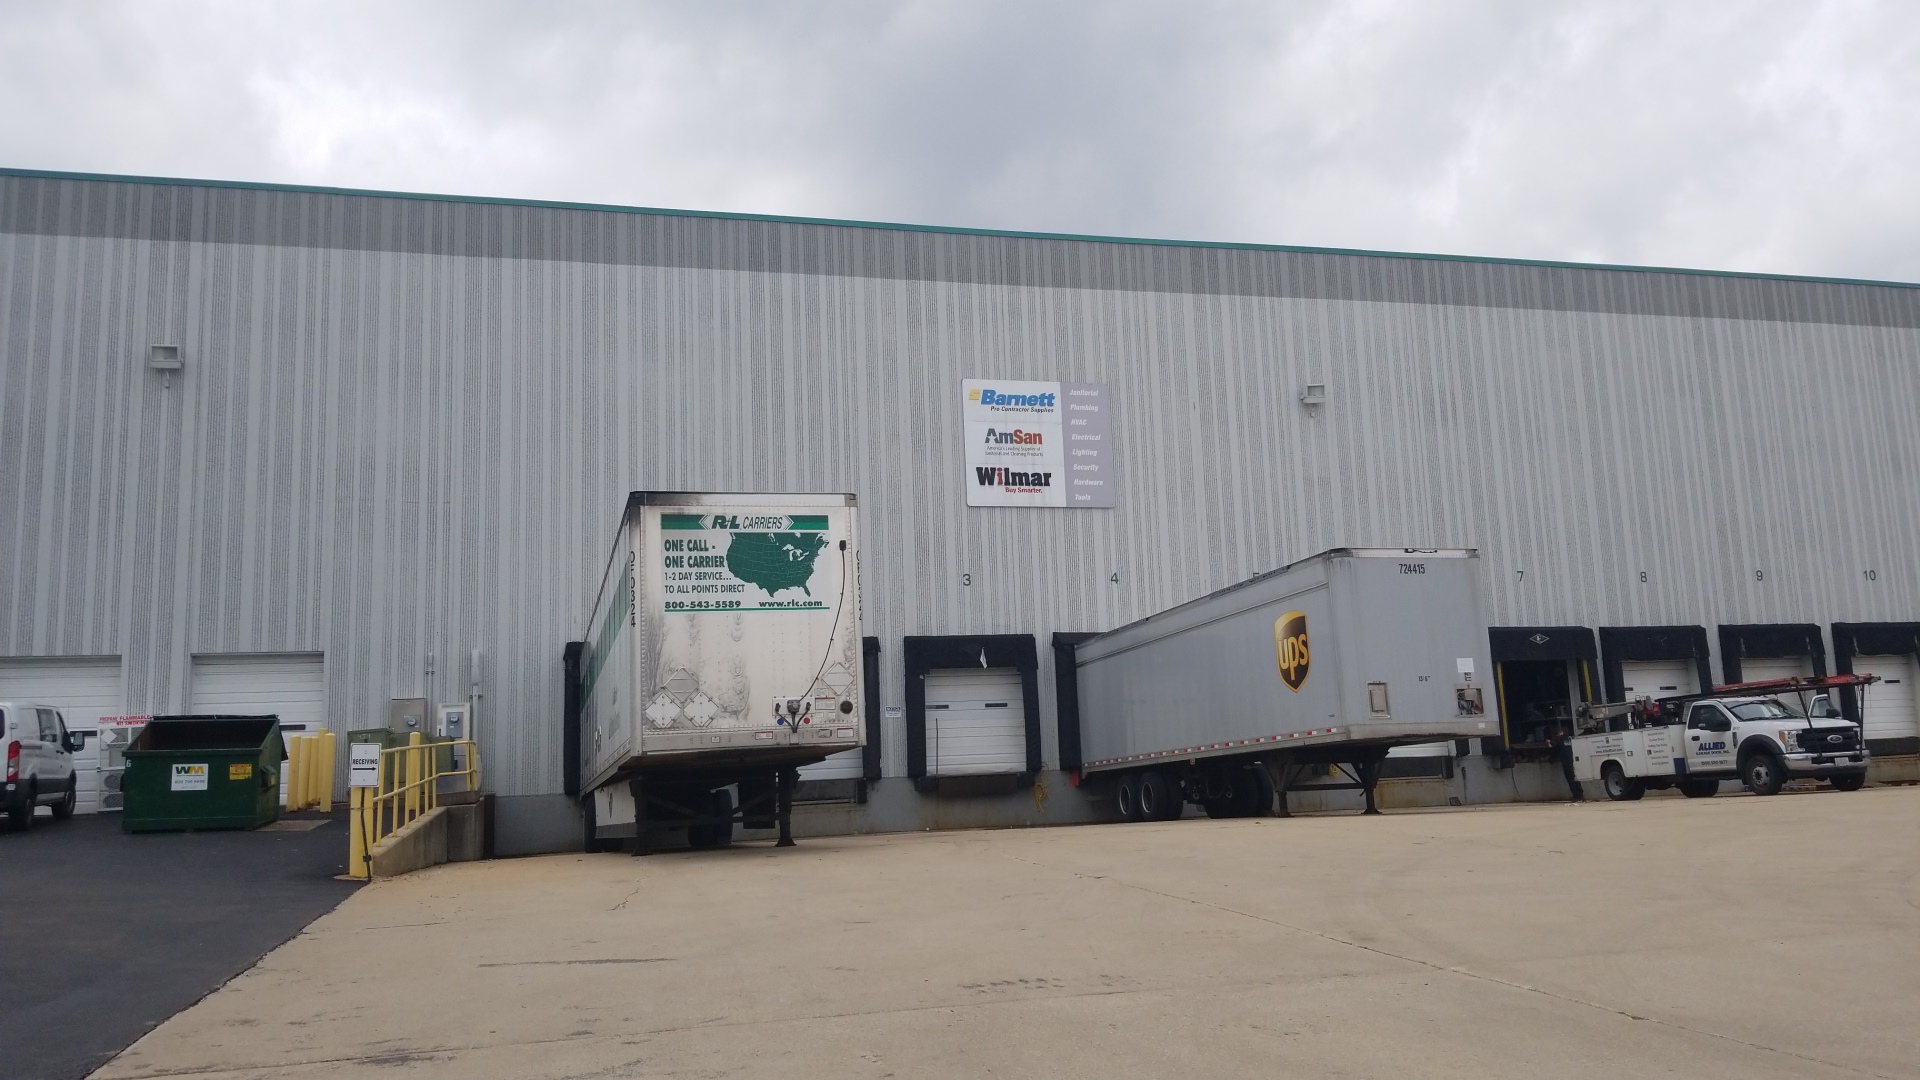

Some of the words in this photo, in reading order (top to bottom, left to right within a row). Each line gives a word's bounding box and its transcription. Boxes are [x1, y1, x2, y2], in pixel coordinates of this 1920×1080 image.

[981, 389, 1055, 407] Barnett
[1070, 404, 1099, 412] Plumbing
[984, 428, 1042, 445] AmSan
[1073, 464, 1099, 472] Security
[976, 467, 1051, 487] Wilmar
[742, 516, 783, 529] CARRIERS
[664, 539, 684, 552] ONE
[687, 539, 709, 552] CALL
[664, 555, 684, 568] ONE
[687, 555, 725, 568] CARRIER
[1399, 563, 1426, 575] 724415
[664, 572, 676, 581] 1-2
[678, 572, 693, 581] DAY
[962, 573, 972, 586] 3
[1110, 572, 1119, 584] 4
[1516, 570, 1524, 582] 7
[1640, 572, 1647, 583] 8
[1756, 570, 1763, 581] 9
[1863, 570, 1876, 581] 10
[664, 585, 675, 594] TO
[676, 585, 690, 594] ALL
[691, 584, 719, 593] POINTS
[720, 584, 745, 593] DIRECT
[664, 600, 741, 609] 800-543-5589
[758, 599, 823, 608] www.rlc.com
[1278, 633, 1309, 681] ups
[1698, 741, 1726, 751] ALLIED
[175, 766, 205, 775] WM
